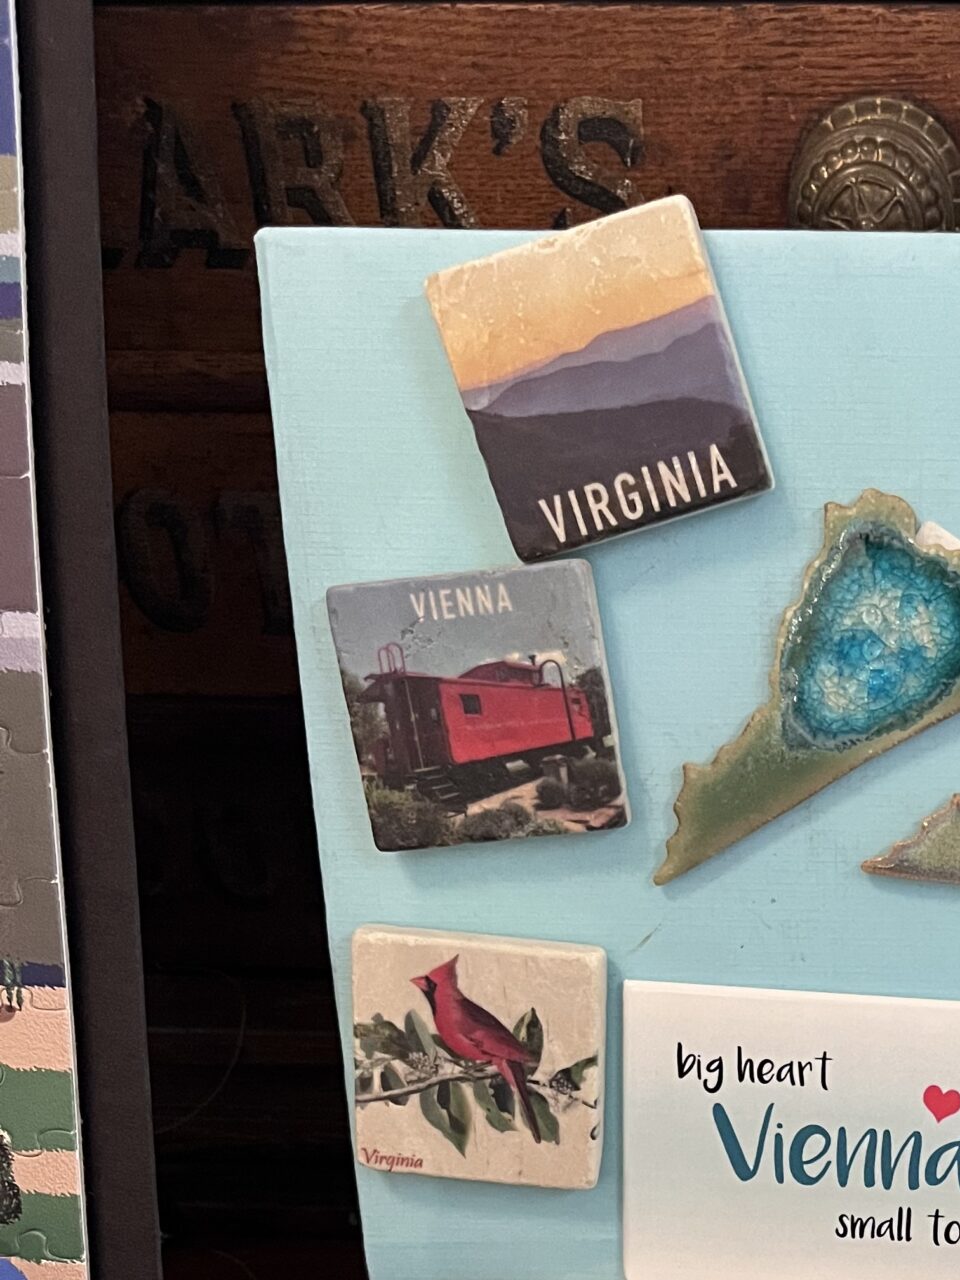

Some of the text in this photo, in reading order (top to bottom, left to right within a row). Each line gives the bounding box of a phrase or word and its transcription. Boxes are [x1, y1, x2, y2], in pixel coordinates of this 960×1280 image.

[103, 97, 644, 268] ARK'S
[537, 443, 739, 544] VIRGINIA
[409, 582, 514, 623] VIENNA
[676, 1041, 834, 1094] big heart
[360, 1147, 424, 1173] Virginia
[834, 1205, 913, 1243] small
